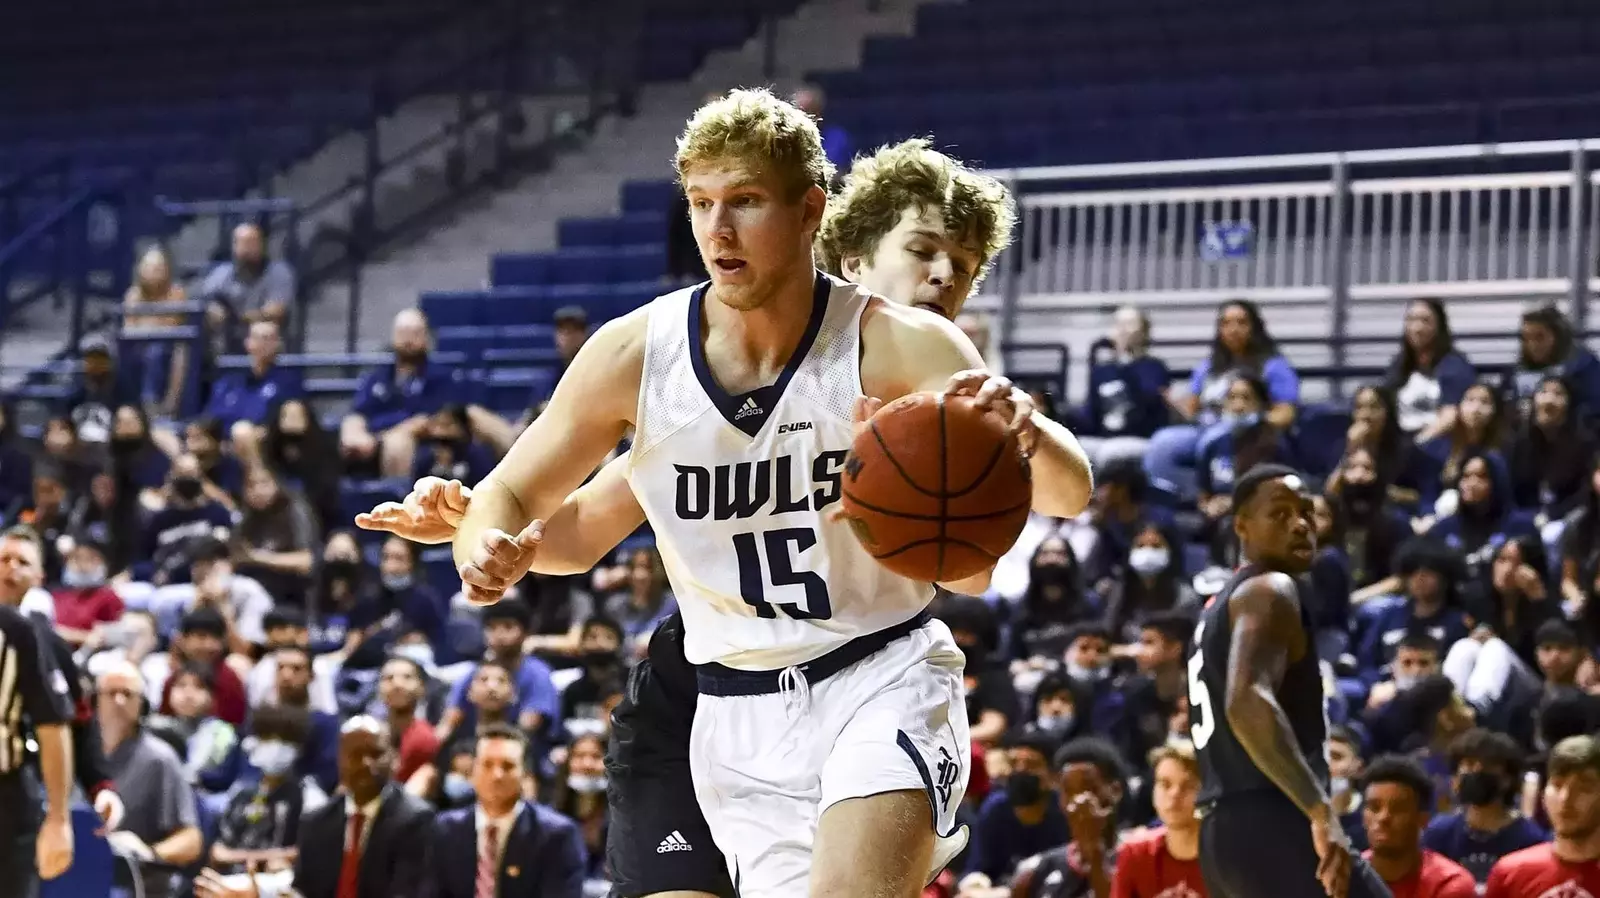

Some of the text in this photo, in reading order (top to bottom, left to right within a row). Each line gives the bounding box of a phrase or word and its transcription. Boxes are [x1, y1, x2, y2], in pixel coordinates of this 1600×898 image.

[734, 407, 764, 420] adidas
[673, 449, 849, 520] OWLS
[732, 528, 832, 620] 15
[656, 843, 693, 853] adidas
